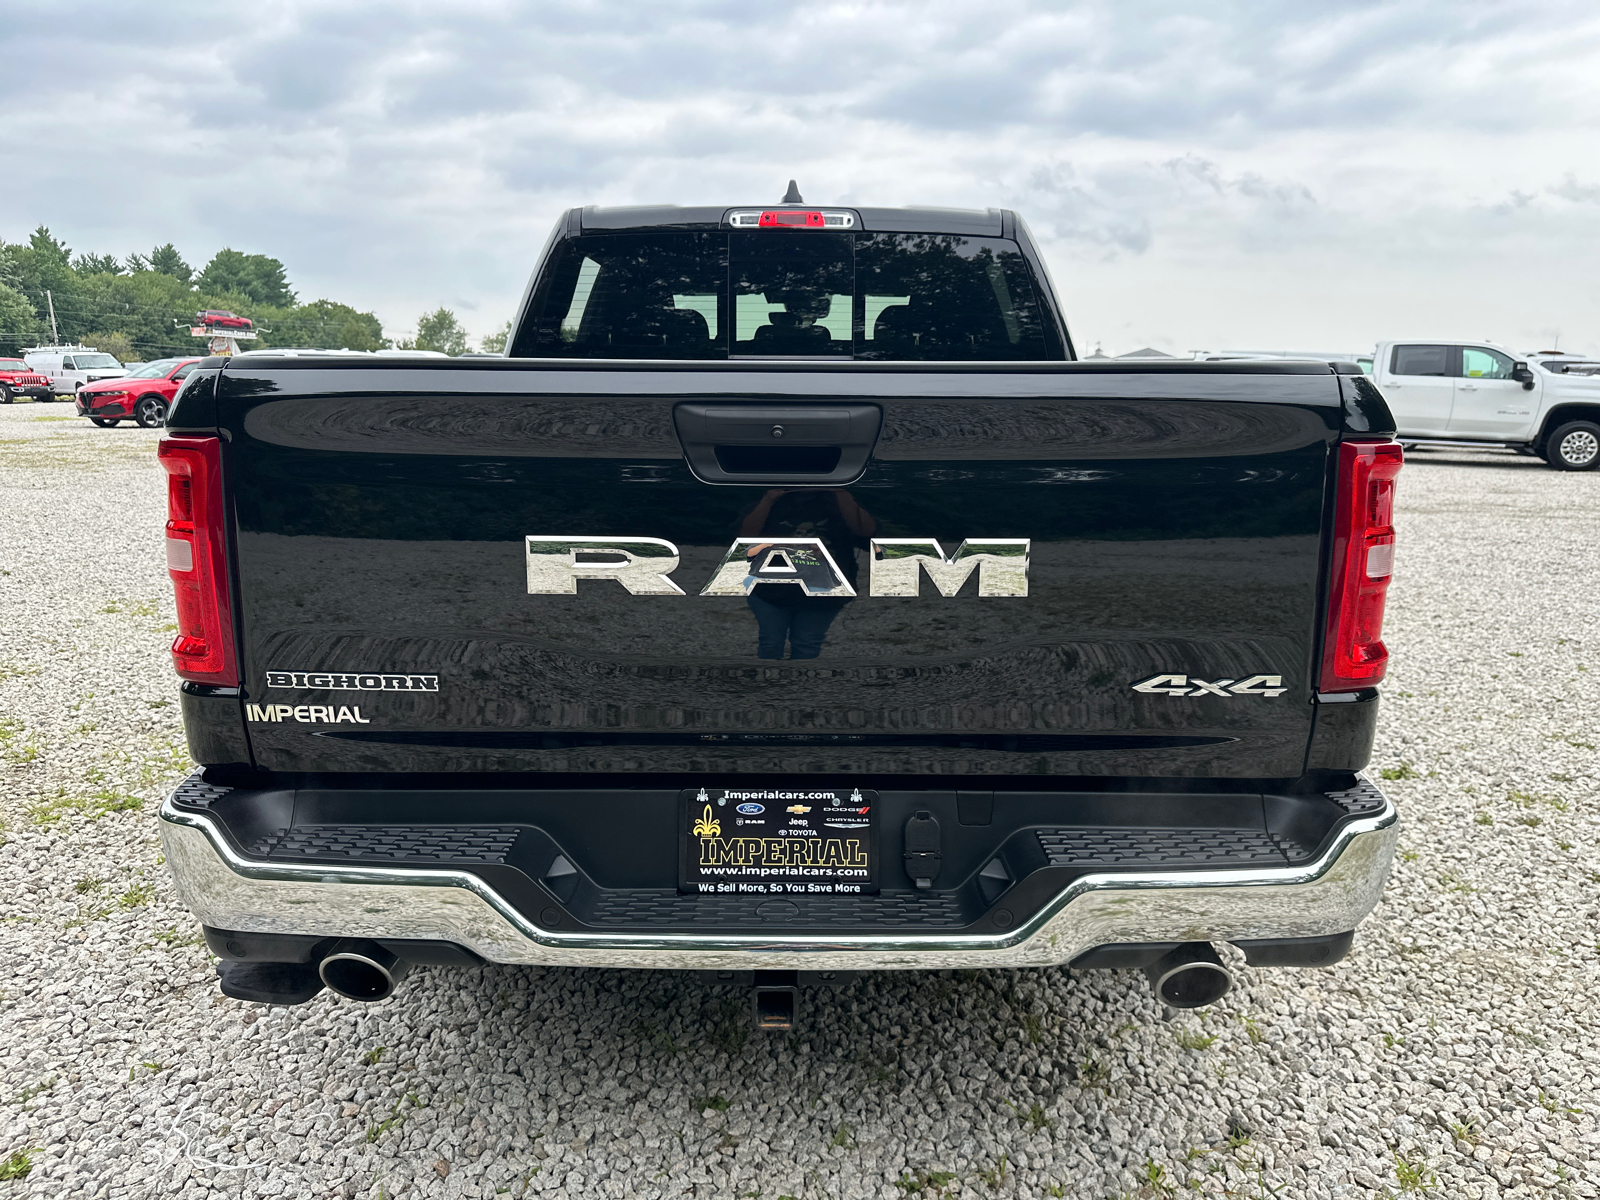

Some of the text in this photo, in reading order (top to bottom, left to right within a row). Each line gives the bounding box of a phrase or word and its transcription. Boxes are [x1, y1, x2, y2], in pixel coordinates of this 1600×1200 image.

[525, 535, 1031, 598] RAM
[266, 671, 439, 692] BIGHORN
[1132, 674, 1288, 697] 4x4
[246, 703, 370, 723] IMPERIAL
[724, 790, 835, 801] Imperialcars.com
[788, 817, 808, 827] Jeep
[700, 838, 868, 867] IMPERIAL
[700, 866, 868, 877] www.imperialcars.com
[698, 883, 861, 894] We Sell More, So You Save More
